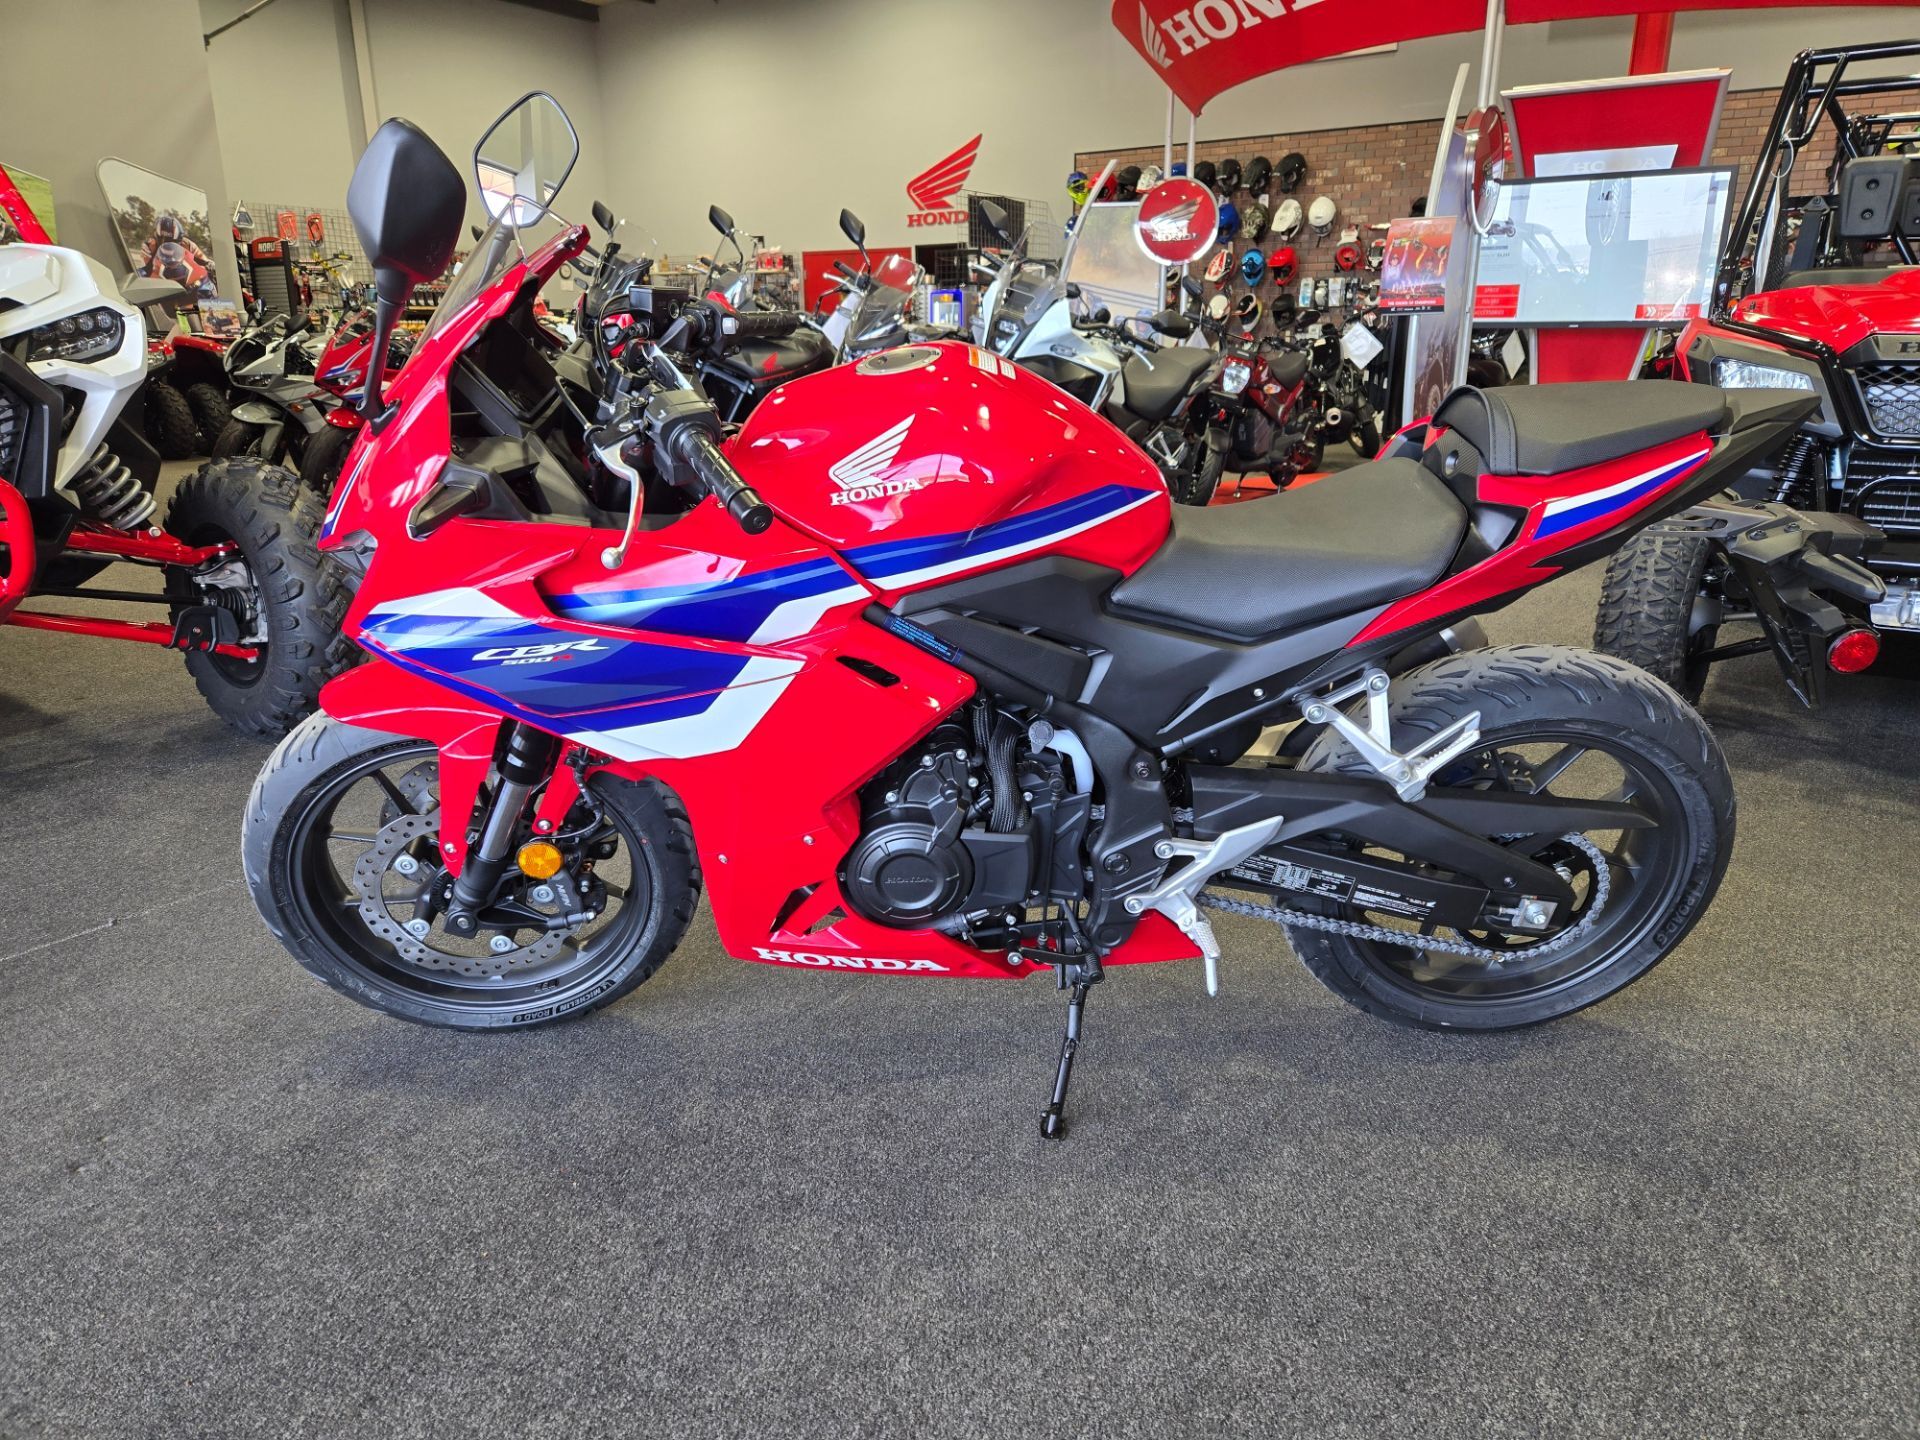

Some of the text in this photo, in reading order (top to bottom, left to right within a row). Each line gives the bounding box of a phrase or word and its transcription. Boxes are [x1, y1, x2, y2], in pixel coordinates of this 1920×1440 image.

[1160, 0, 1326, 56] HON
[907, 210, 970, 228] HOND
[830, 478, 924, 506] HONDA
[471, 638, 610, 661] CBR
[751, 947, 950, 971] HONDA
[559, 987, 602, 1011] MICHELIN
